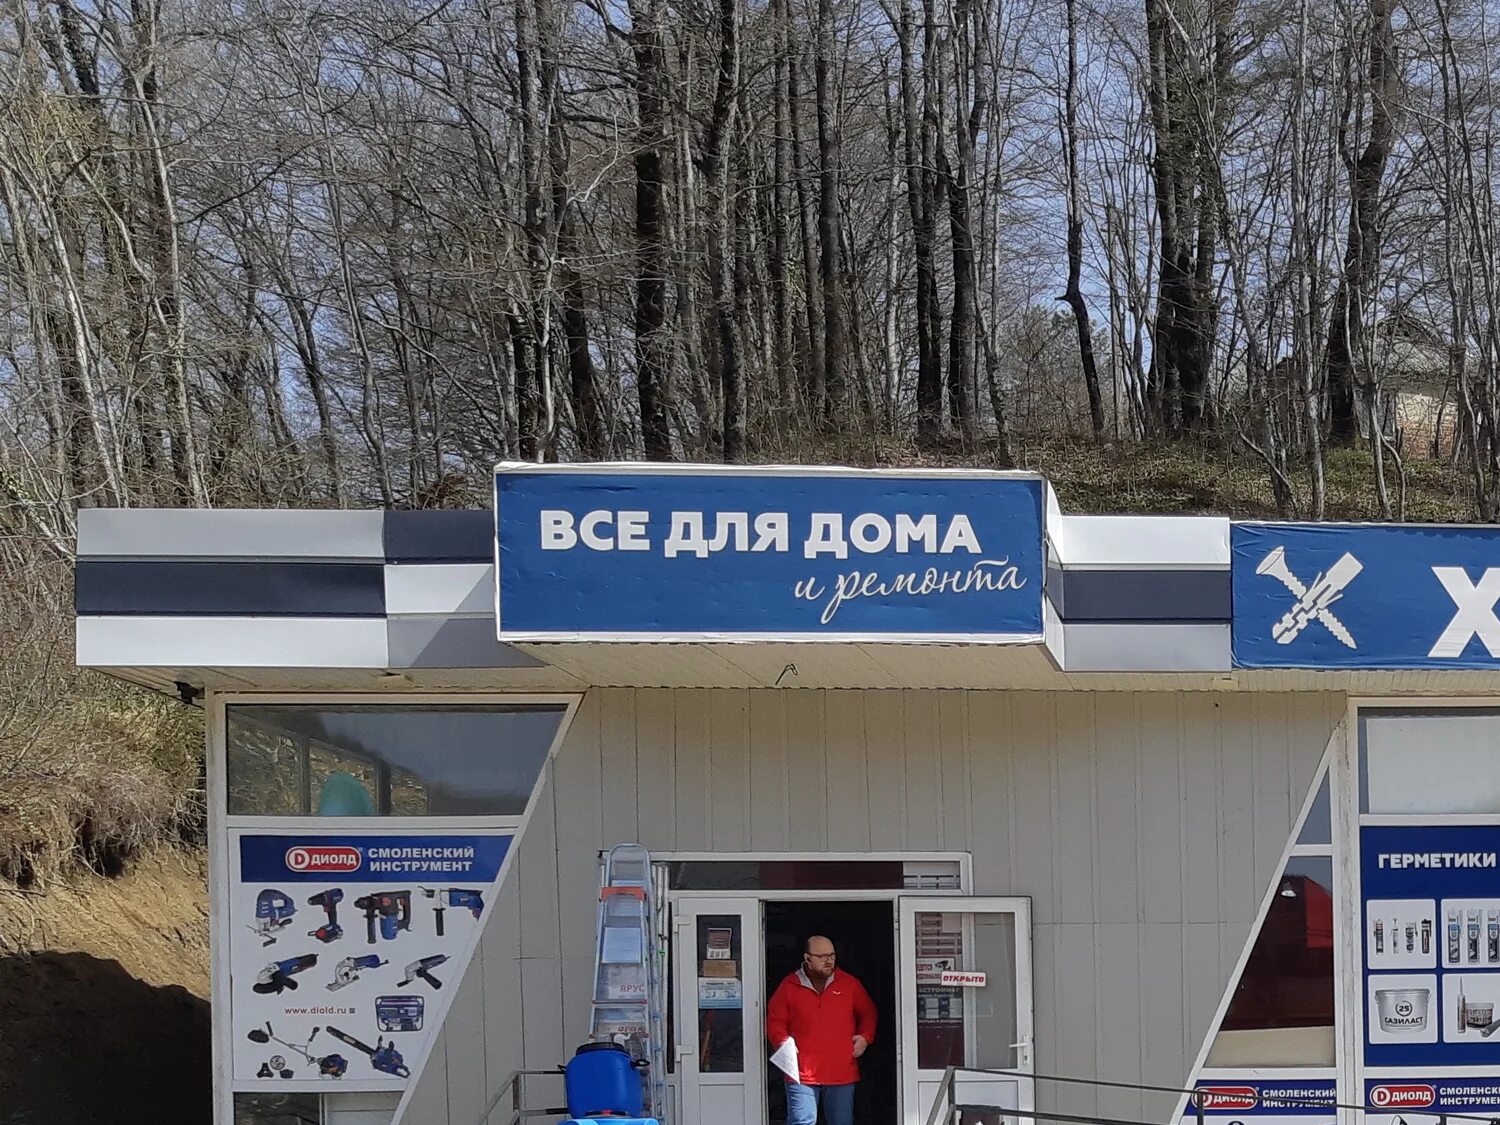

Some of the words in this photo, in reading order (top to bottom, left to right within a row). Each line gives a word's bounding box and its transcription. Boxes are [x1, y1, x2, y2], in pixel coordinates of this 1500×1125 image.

[540, 510, 650, 551] ВСЕ
[664, 511, 789, 558] ДЛЯ
[804, 512, 982, 560] ДОМА
[793, 576, 825, 601] и
[820, 555, 1027, 624] ремонта
[368, 847, 475, 859] СМОЛЕНСКИЙ
[311, 853, 357, 866] ДИОЛД
[1378, 852, 1497, 869] ГЕРМЕТИКИ
[370, 861, 473, 872] ИНСТРУМЕНТ
[943, 975, 985, 983] ОТКРЫТО
[284, 1006, 347, 1014] www.diold.ru
[1384, 1016, 1423, 1025] САЗИЛАСТ
[1263, 1088, 1336, 1097] СМОЛЕНСКИЙ
[1392, 1090, 1431, 1102] ДИОЛД
